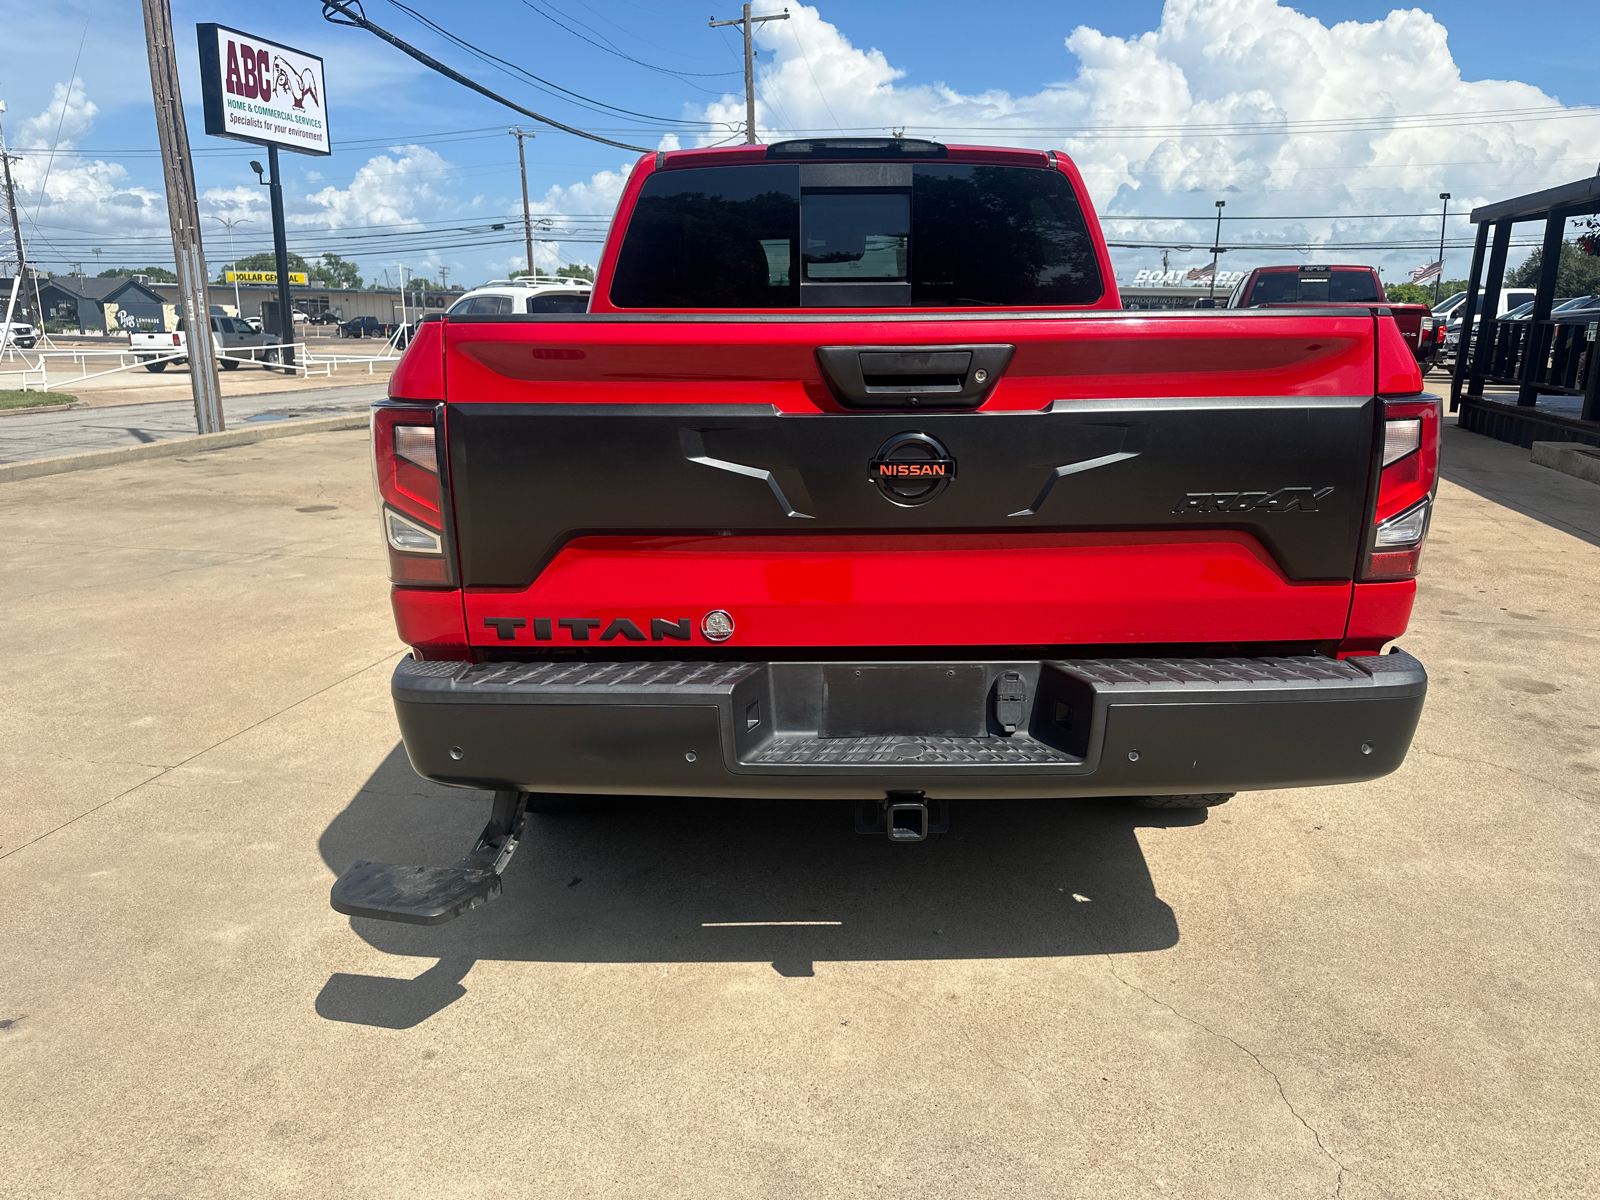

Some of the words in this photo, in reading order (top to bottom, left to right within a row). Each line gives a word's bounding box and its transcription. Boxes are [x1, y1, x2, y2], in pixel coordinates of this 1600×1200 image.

[226, 40, 271, 102] ABC
[227, 99, 246, 111] HOME
[247, 103, 253, 112] &
[253, 104, 294, 122] COMMERCIAL
[294, 114, 322, 129] SERVICES
[229, 112, 263, 129] Specialists
[264, 120, 273, 131] for
[273, 124, 287, 134] your
[288, 128, 323, 142] environment
[233, 273, 263, 282] DOLLAR
[265, 273, 299, 282] GEAL
[1133, 269, 1188, 284] BOAT
[1120, 296, 1159, 304] OWROOM
[880, 464, 945, 476] NISSAN
[484, 617, 692, 640] TITAN
